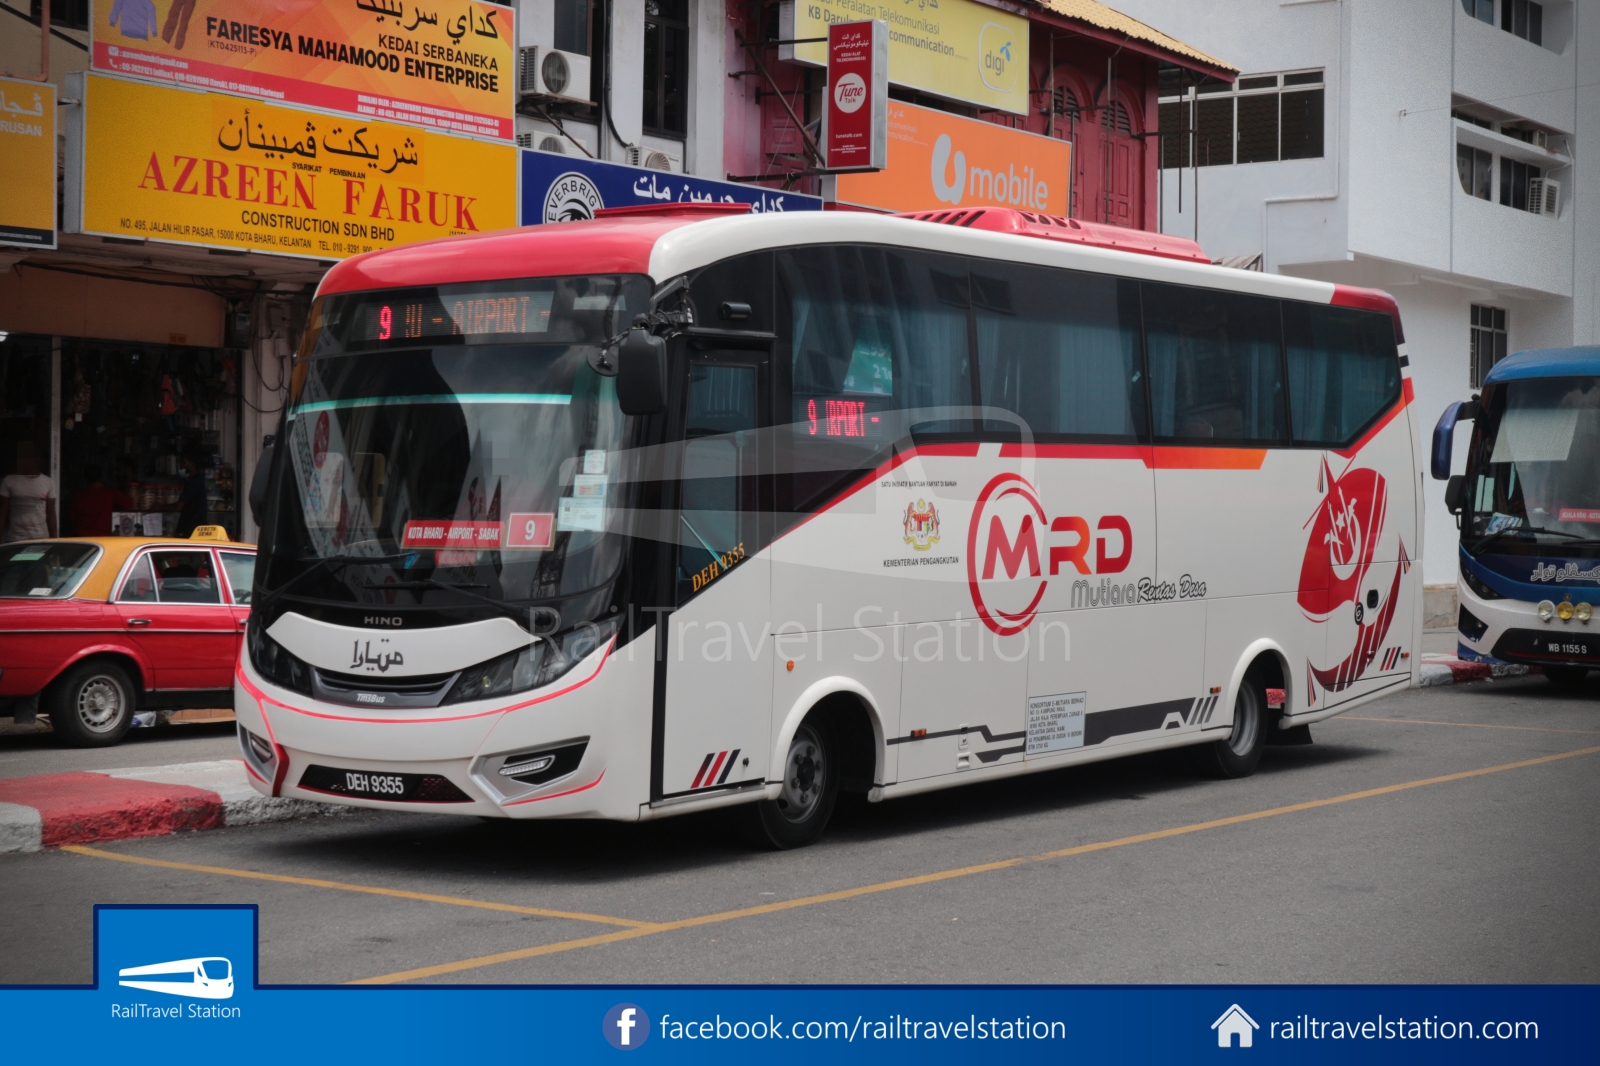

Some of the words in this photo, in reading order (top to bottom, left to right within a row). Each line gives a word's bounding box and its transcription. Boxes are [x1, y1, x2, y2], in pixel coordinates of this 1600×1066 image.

[446, 5, 499, 46] كداي
[808, 5, 821, 20] KB
[879, 5, 940, 35] Telekomunikasi
[206, 16, 294, 53] FARIESYA
[298, 35, 400, 73] MAHAMOOD
[404, 57, 499, 93] ENTERPRISE
[378, 33, 419, 55] KEDAI
[423, 43, 499, 72] SERBANEKA
[838, 83, 864, 102] Tune
[323, 127, 418, 174] شريكت
[292, 161, 323, 173] SYARIKAT
[329, 167, 366, 180] PEMBINAAN
[970, 163, 1049, 210] mobile
[138, 151, 317, 210] AZREEN
[343, 178, 480, 232] FARUK
[120, 218, 133, 229] NO.
[134, 220, 148, 231] 495,
[149, 221, 172, 233] JALAN
[173, 224, 191, 236] HILIR
[192, 226, 216, 239] PASAR,
[217, 229, 234, 240] 15000
[235, 231, 253, 242] KOTA
[254, 233, 278, 246] BHARU,
[279, 235, 312, 249] KELANTAN
[319, 240, 332, 251] TEL.
[333, 242, 342, 252] 010
[241, 210, 340, 235] CONSTRUCTION
[343, 222, 368, 238] SDN
[371, 226, 395, 241] BHD
[379, 305, 392, 340] 9
[452, 296, 531, 336] AIRPORT
[807, 399, 817, 435] 9
[408, 527, 423, 539] KOTA
[423, 527, 444, 539] BHARU
[448, 527, 474, 540] AIRPORT
[479, 528, 500, 541] SABAK
[525, 519, 536, 541] 9
[691, 565, 719, 592] DEH
[720, 542, 746, 572] 9355
[883, 558, 919, 567] KEMENTERIAN
[920, 556, 959, 566] PENGANGKUTAN
[1070, 578, 1136, 609] Mutiara
[1136, 576, 1177, 603] Rentas
[1179, 573, 1207, 599] Desa
[364, 616, 403, 626] HINO
[1548, 643, 1560, 652] WB
[1562, 644, 1580, 654] 1155
[1581, 645, 1587, 654] S
[345, 772, 369, 793] DEH
[371, 774, 404, 795] 9355
